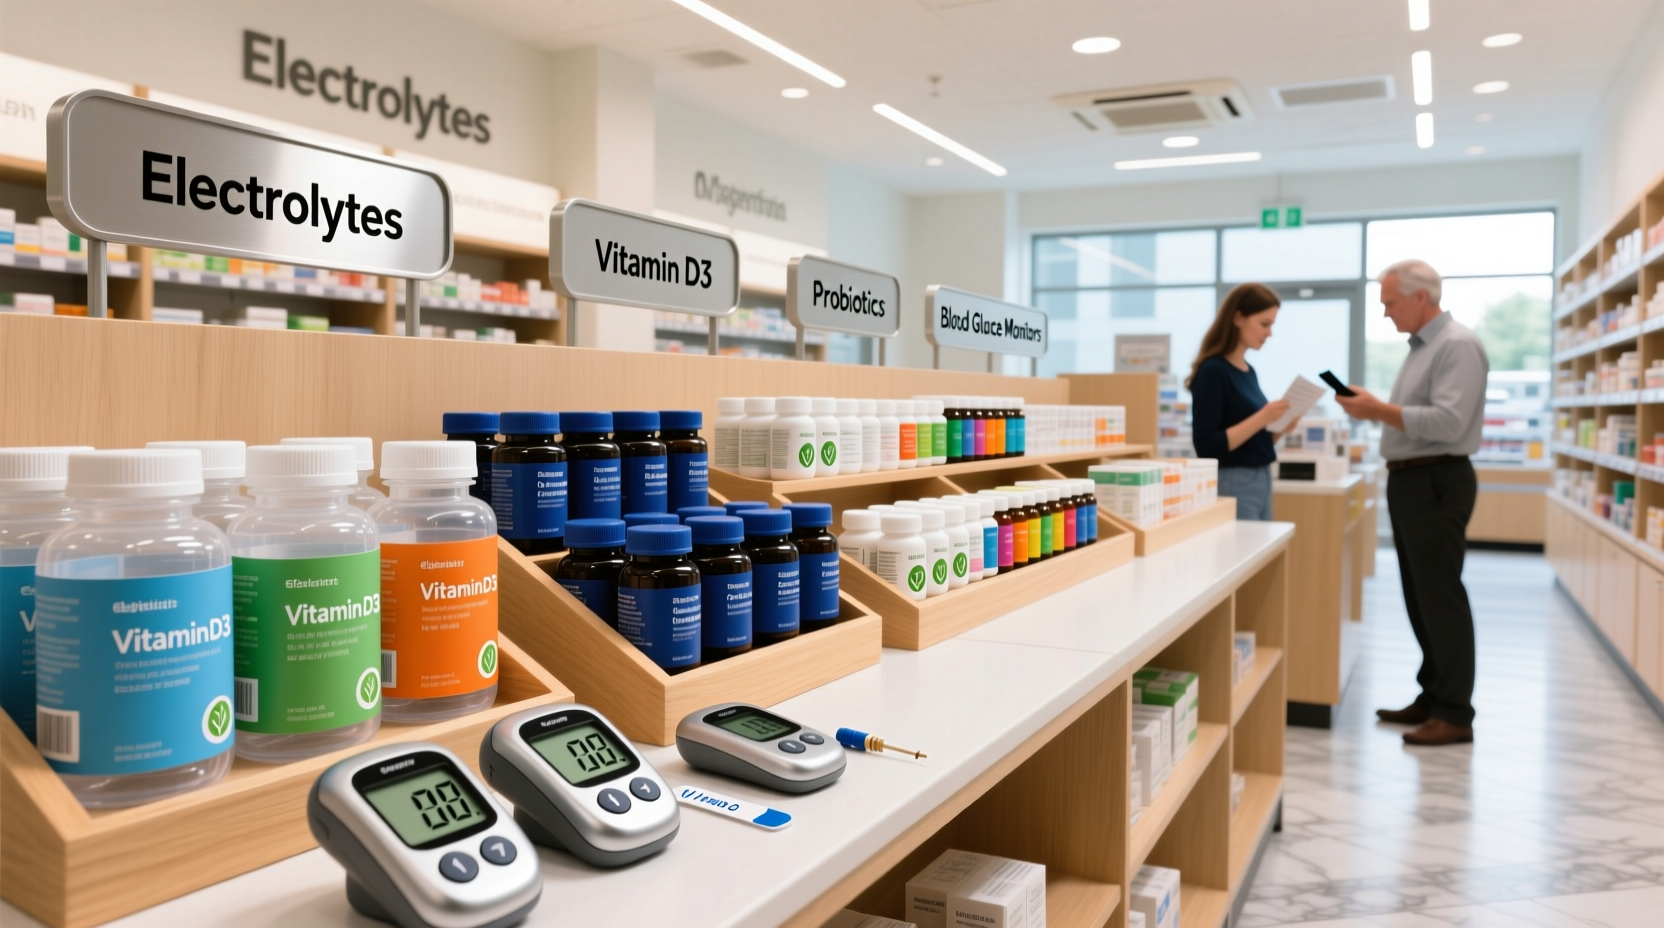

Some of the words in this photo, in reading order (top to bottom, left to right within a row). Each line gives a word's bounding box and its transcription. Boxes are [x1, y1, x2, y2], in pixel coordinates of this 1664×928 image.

[241, 29, 492, 145] Electrolytes
[141, 150, 404, 243] Electrolytes
[595, 238, 680, 284] Vitamin
[685, 255, 713, 289] D3
[813, 280, 886, 317] Probiotics
[420, 574, 498, 601] VitaminD3
[284, 592, 380, 627] VitaminD3
[111, 613, 231, 655] VitaminD3
